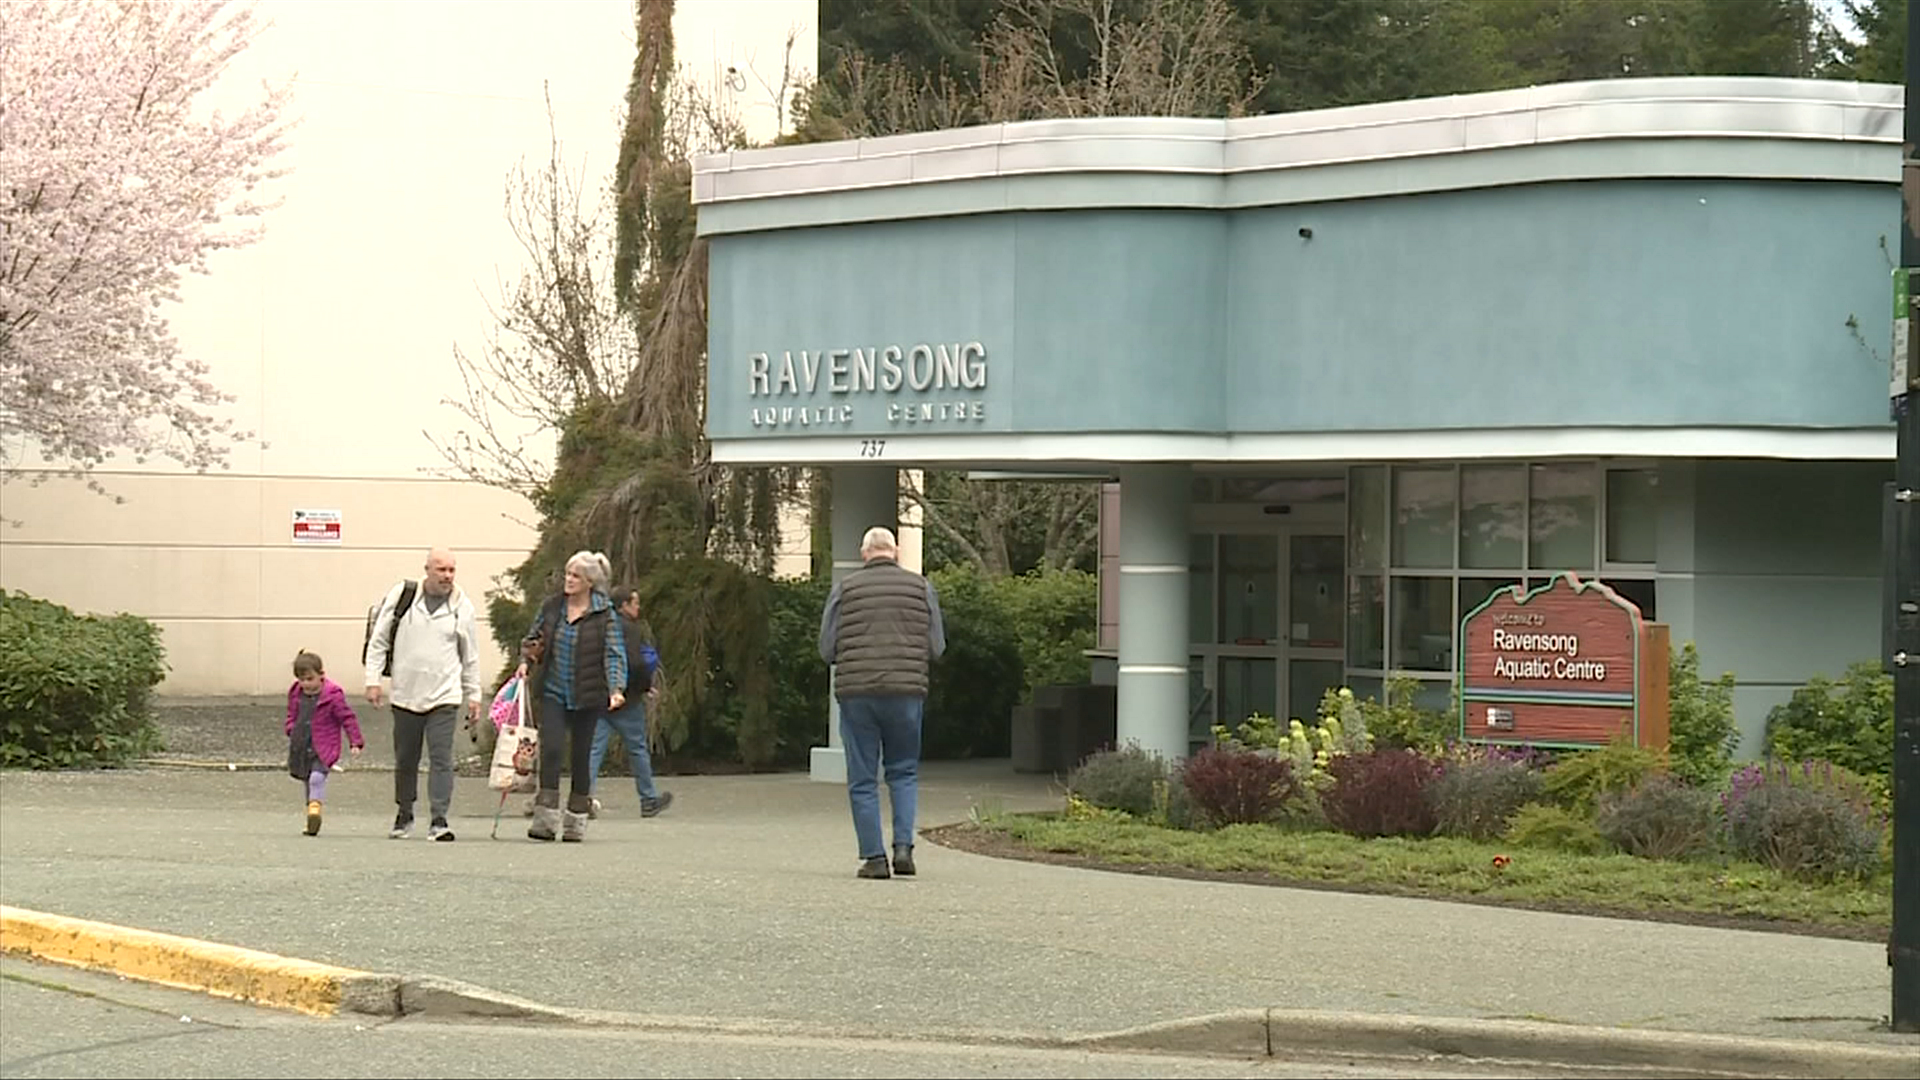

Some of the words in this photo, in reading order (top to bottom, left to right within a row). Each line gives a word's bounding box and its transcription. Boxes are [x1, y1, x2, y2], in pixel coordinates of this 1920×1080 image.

[750, 341, 987, 396] RAVENSONG
[751, 405, 852, 426] AQUATIC
[887, 402, 985, 423] CENTRE
[860, 440, 886, 457] 737
[1493, 629, 1578, 656] Ravensong
[1494, 656, 1550, 681] Aquatic
[1554, 658, 1605, 680] Centre
